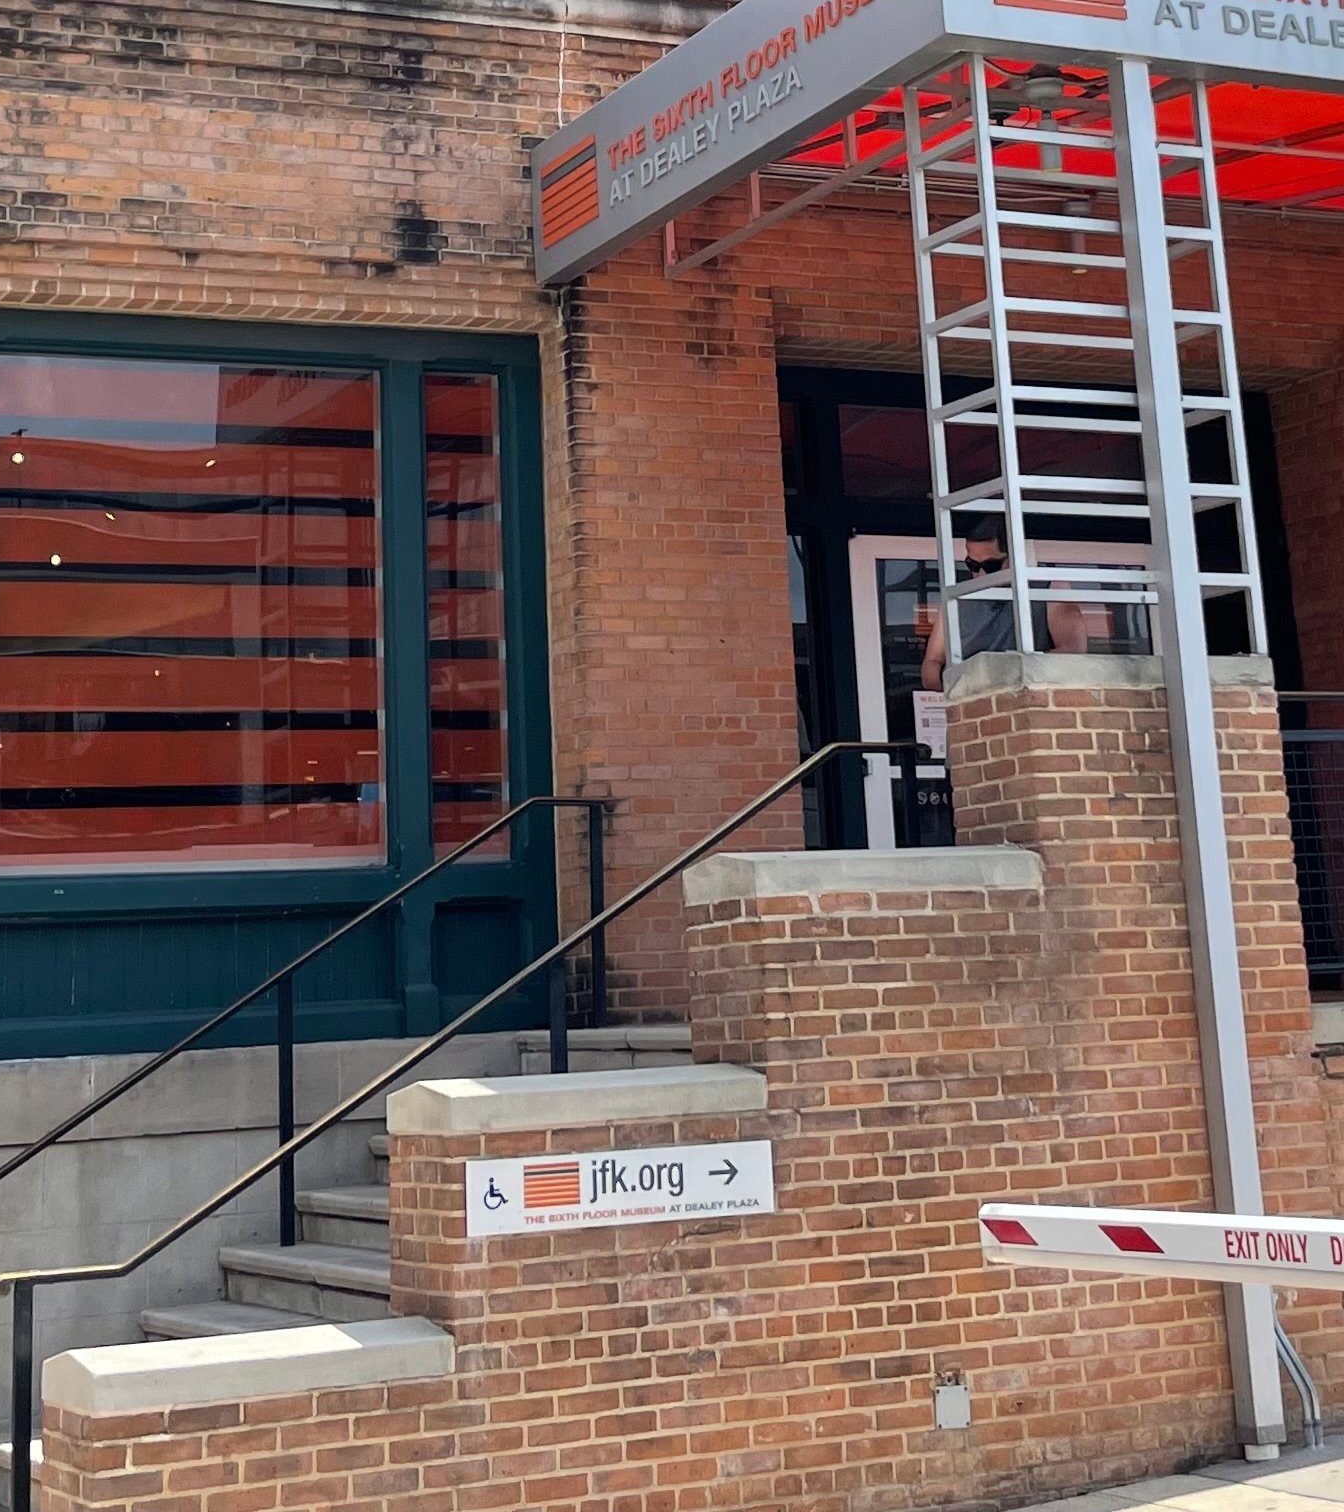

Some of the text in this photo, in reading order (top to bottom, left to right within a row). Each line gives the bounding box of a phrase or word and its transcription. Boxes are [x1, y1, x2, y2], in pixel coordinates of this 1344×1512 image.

[606, 125, 647, 170] THE
[652, 80, 714, 141] SIXTH
[719, 26, 797, 99] FLOOR
[609, 64, 804, 208] AT DEALEY PLAZA
[589, 1158, 684, 1204] jfk.org
[524, 1198, 760, 1225] THE SIXTH FLOOR MUSEUM AT DEALEY PLAZA
[1223, 1230, 1309, 1263] EXIT ONLY
